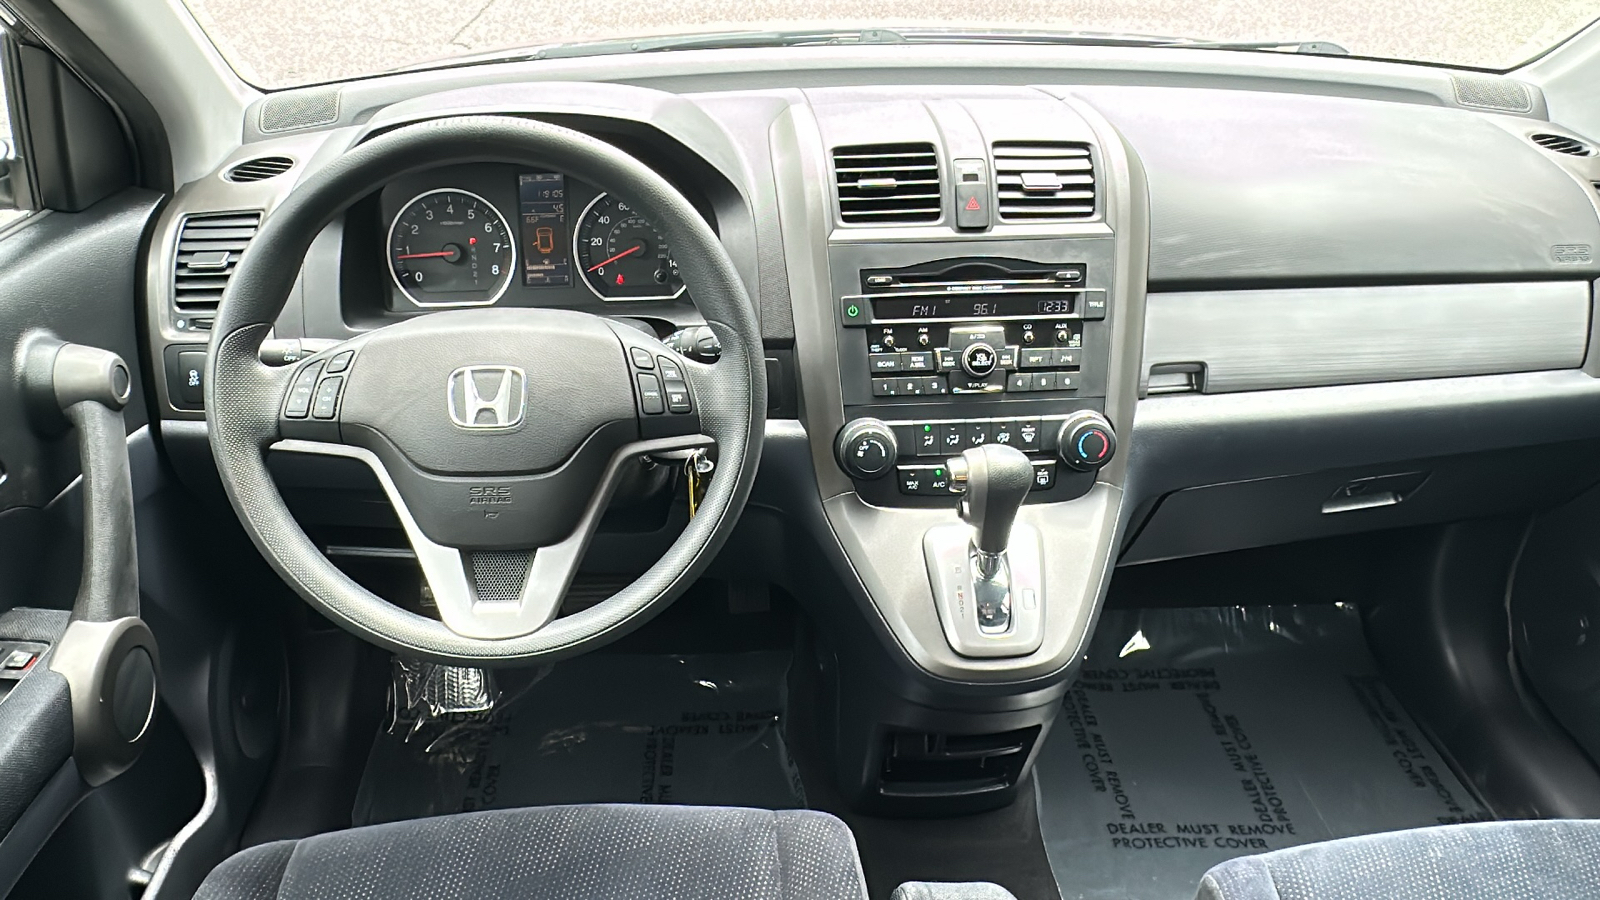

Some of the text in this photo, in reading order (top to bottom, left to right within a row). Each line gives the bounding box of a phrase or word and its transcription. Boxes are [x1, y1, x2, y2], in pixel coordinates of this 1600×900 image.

[446, 204, 453, 214] 4
[426, 211, 434, 220] 3
[467, 210, 475, 219] 5
[598, 216, 610, 224] 40
[411, 225, 419, 234] 2
[484, 223, 492, 232] 6
[591, 238, 602, 246] 20
[493, 243, 501, 253] 7
[492, 265, 499, 275] 8
[598, 267, 604, 276] 0
[415, 272, 423, 282] 0
[469, 486, 511, 496] SRS
[1122, 682, 1160, 692] MUST
[1220, 740, 1247, 772] MUST
[1224, 714, 1290, 822] PROTECTIVE COVER
[1082, 754, 1106, 793] COVER
[1092, 732, 1113, 765] MUST
[1106, 770, 1135, 820] REMOVE
[658, 784, 672, 802] MU
[1241, 779, 1273, 822] DEALER
[1107, 823, 1296, 835] DEALER MUST REMOVE
[1113, 837, 1269, 849] PROTECTIVE COVER
